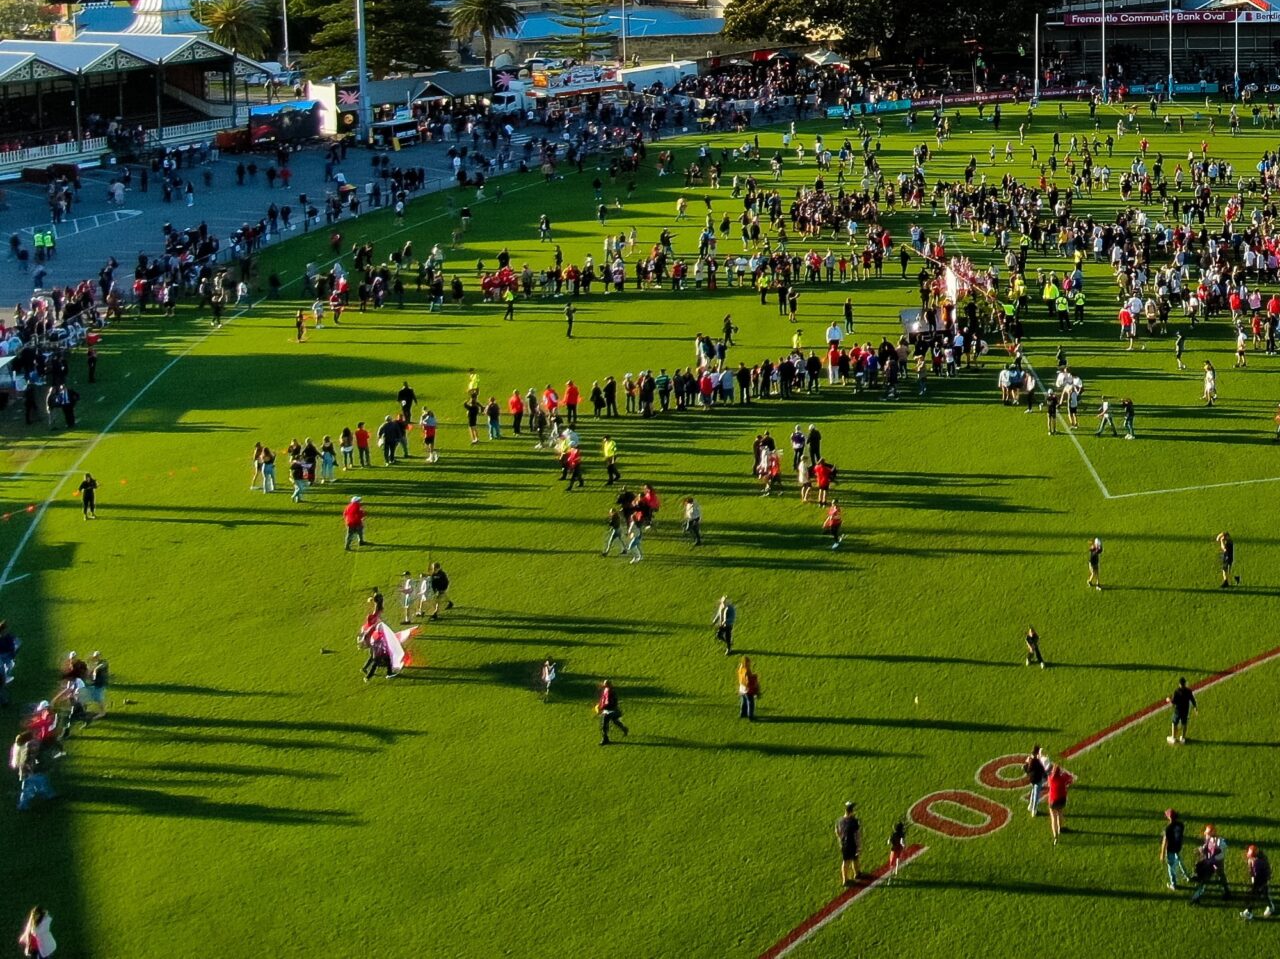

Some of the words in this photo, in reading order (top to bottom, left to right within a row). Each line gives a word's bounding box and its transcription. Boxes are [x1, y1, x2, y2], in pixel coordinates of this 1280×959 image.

[1071, 14, 1118, 23] Fremantle
[1120, 13, 1174, 24] Community
[1176, 12, 1202, 21] Bank
[1202, 12, 1225, 21] Oval
